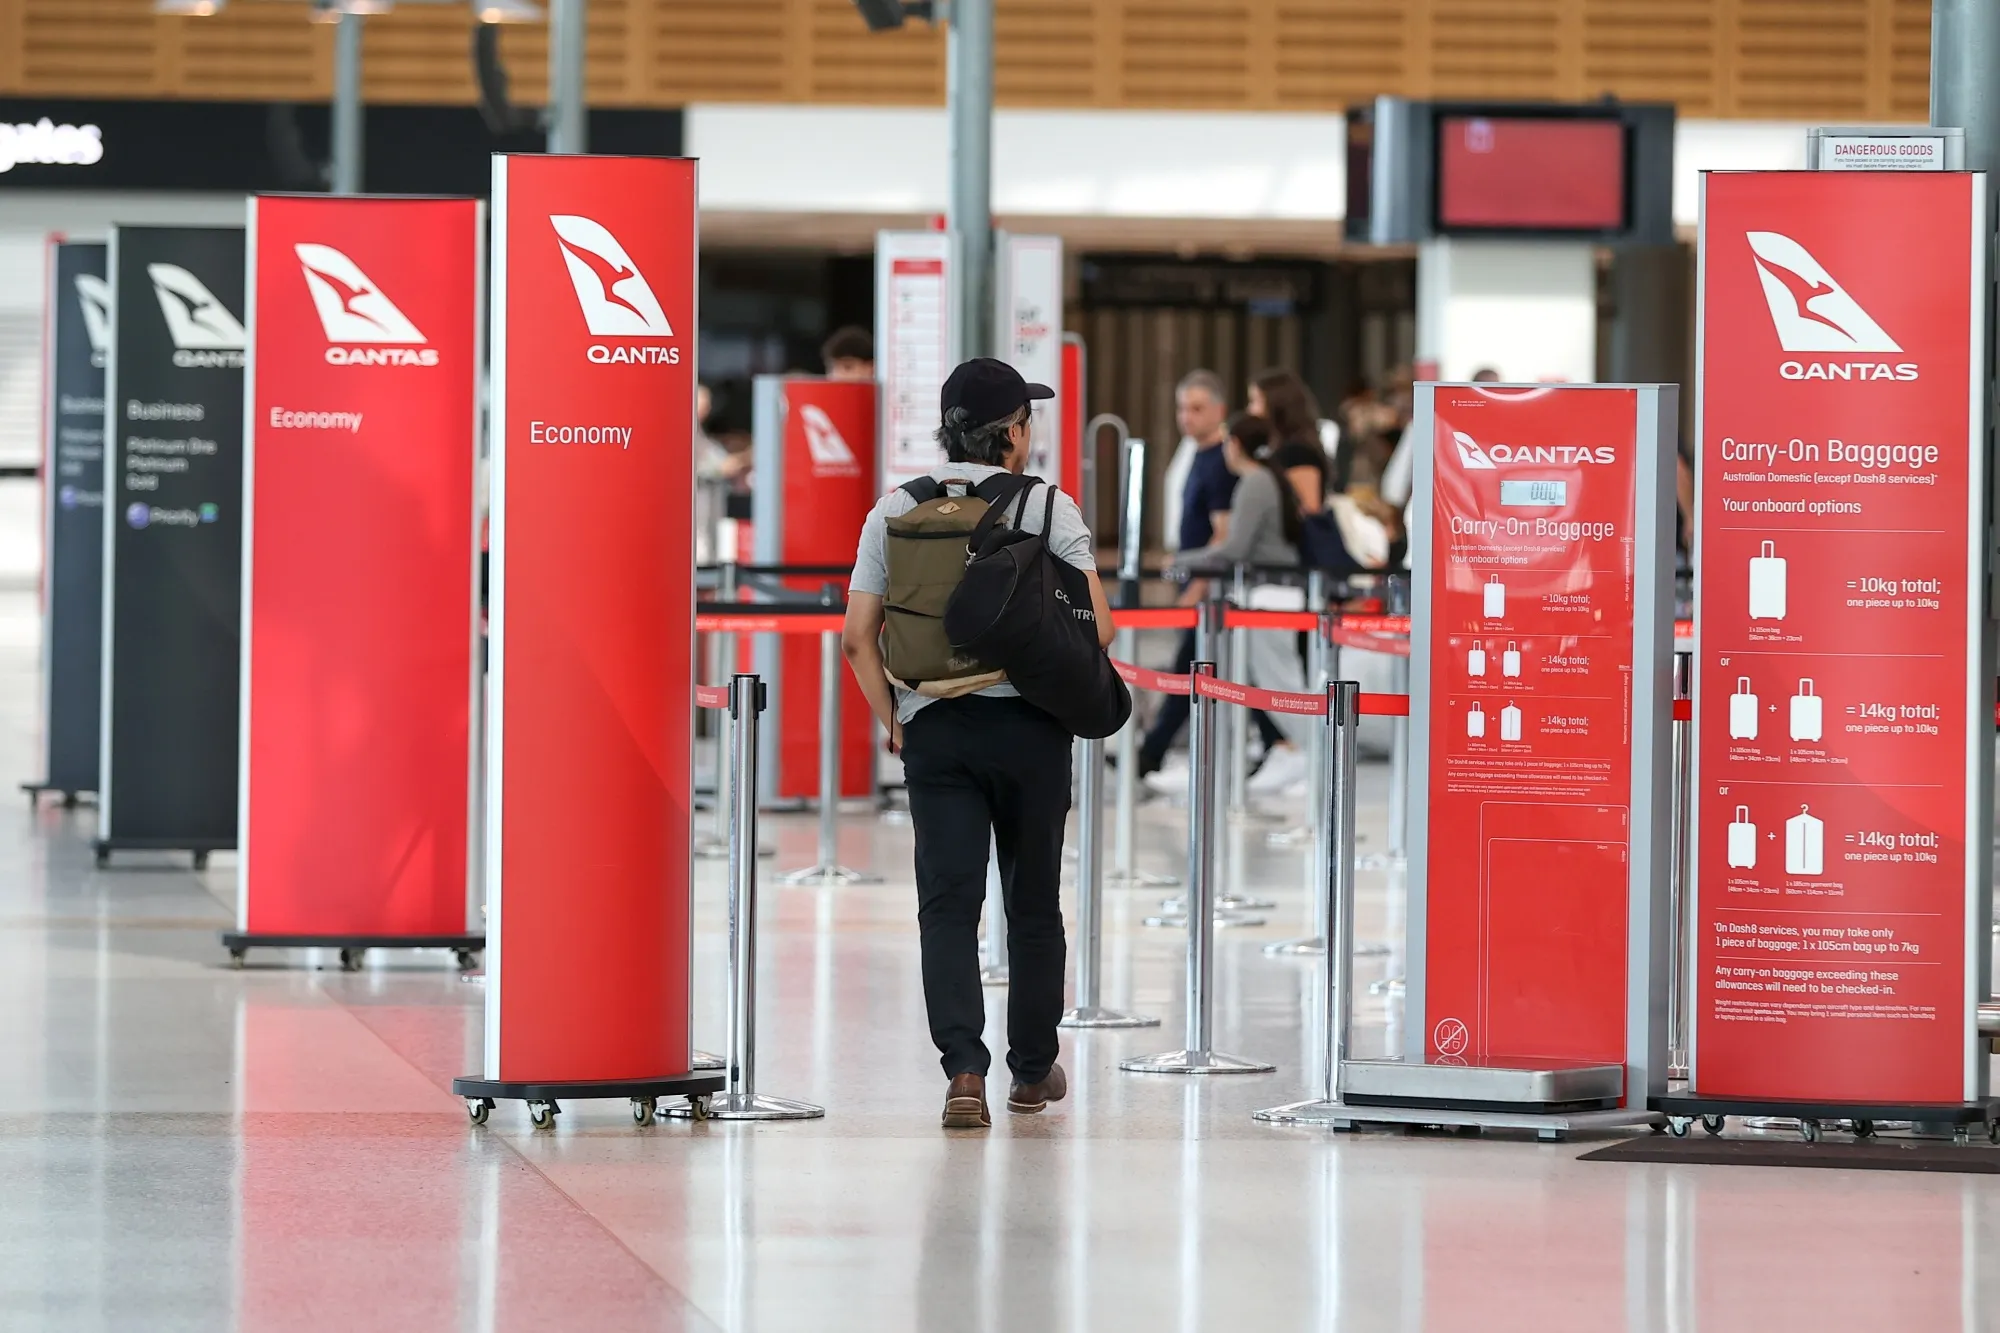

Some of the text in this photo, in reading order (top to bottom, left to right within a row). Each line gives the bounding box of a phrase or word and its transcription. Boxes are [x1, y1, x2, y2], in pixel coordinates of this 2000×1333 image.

[1836, 144, 1933, 155] DANGEROUS GOODS
[172, 350, 245, 368] QANT
[325, 348, 439, 366] QANTAS
[587, 344, 680, 365] QANTAS
[1779, 362, 1919, 380] QANTAS
[270, 408, 364, 434] Economy
[530, 422, 632, 449] Economy
[1490, 444, 1615, 464] QANTAS
[1722, 437, 1938, 468] Carry-On Baggage
[1722, 471, 1766, 482] Australian
[1768, 472, 1812, 483] Domestic
[1814, 473, 1851, 485] (except
[1854, 473, 1886, 484] Dash8
[1722, 498, 1861, 516] Your onboard options
[1451, 516, 1614, 541] Carry-On Baggage
[1450, 555, 1528, 565] Your onboard options
[1860, 578, 1897, 596] 10kg
[1901, 578, 1941, 595] total;
[1549, 594, 1568, 605] 10kg
[1847, 598, 1939, 610] one piece up to 10kg
[1548, 655, 1567, 666] 14kg
[1720, 658, 1730, 666] or
[1859, 703, 1896, 721] 14kg
[1900, 704, 1940, 720] total;
[1548, 715, 1566, 727] 14kg
[1845, 724, 1938, 735] one piece up to 10kg
[1719, 787, 1729, 795] or
[1858, 831, 1895, 850] 14kg
[1898, 832, 1939, 848] total;
[1864, 852, 1888, 862] piece
[1890, 853, 1902, 862] up
[1903, 853, 1913, 861] to
[1914, 852, 1937, 863] 10kg
[1729, 923, 1757, 933] Dash8
[1759, 925, 1800, 936] services,
[1802, 928, 1820, 938] you
[1822, 928, 1845, 939] may
[1847, 928, 1870, 937] take
[1872, 928, 1894, 939] only
[1716, 936, 1919, 954] 1 piece of baggage; 1 x 105cm bag up to 7kg
[1716, 965, 1899, 982] Any carry-on baggage exceeding these
[1715, 979, 1895, 994] allowances will need to be checked-in.
